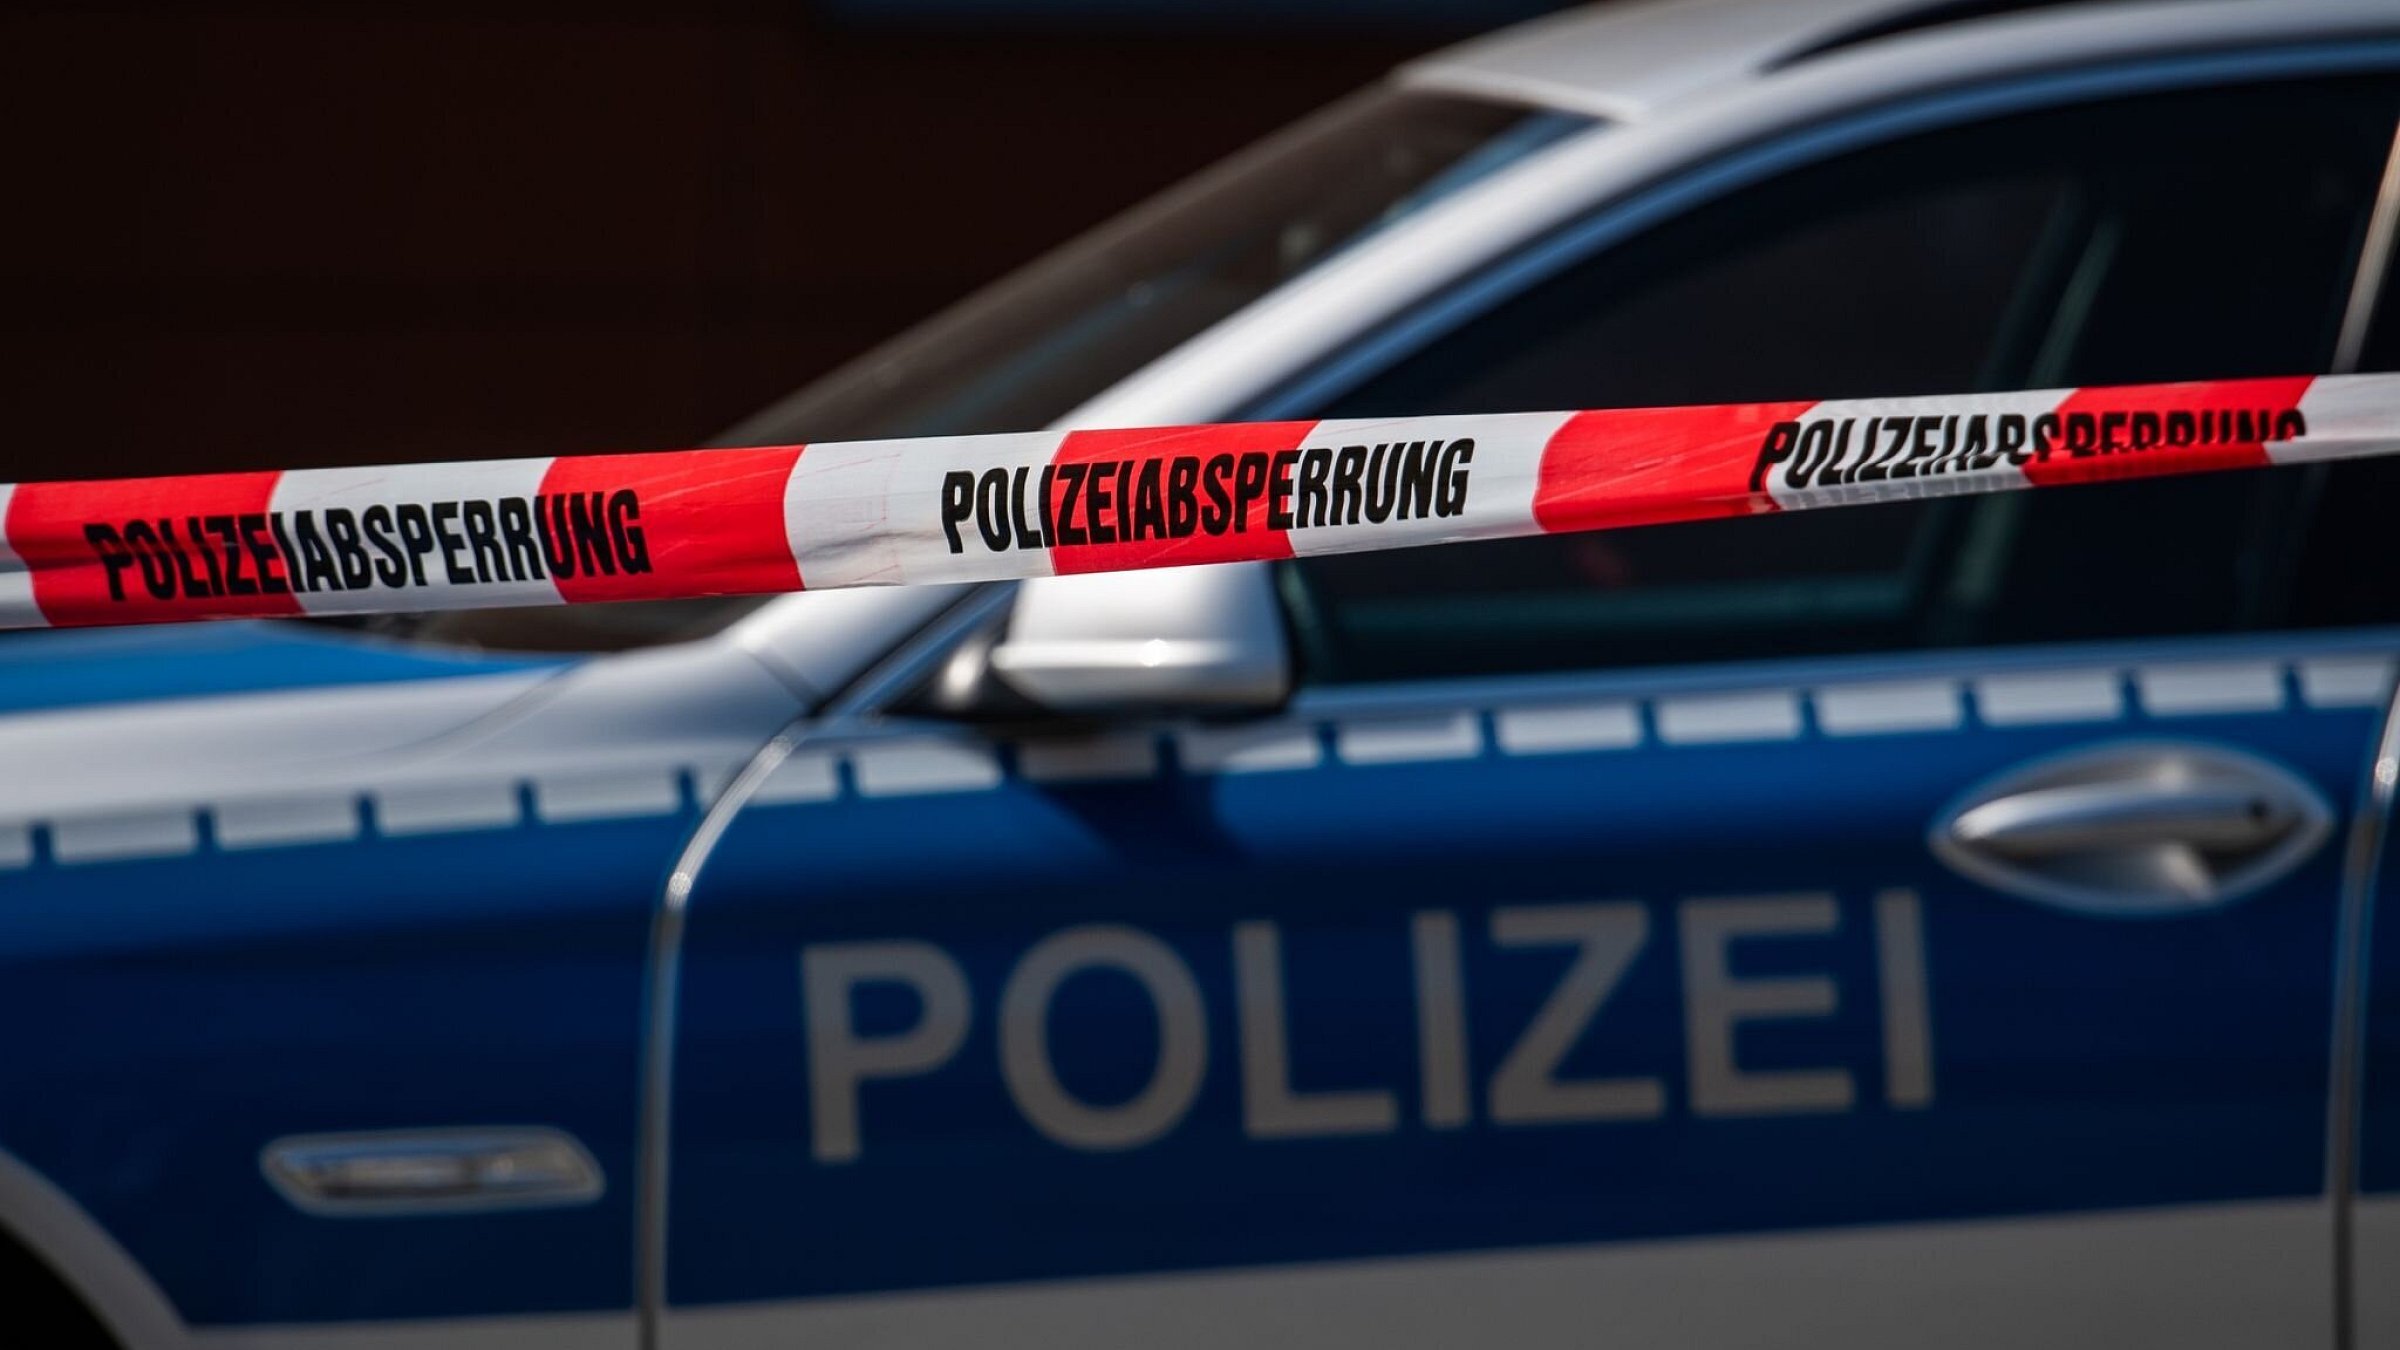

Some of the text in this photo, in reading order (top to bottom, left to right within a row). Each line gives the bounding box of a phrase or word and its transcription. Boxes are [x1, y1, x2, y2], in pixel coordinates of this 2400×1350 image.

[83, 489, 652, 601] POLIZEIABSPERRUNG
[941, 437, 1474, 554] POLIZEIABSPERRUNG
[801, 888, 1934, 1163] POLIZEI
